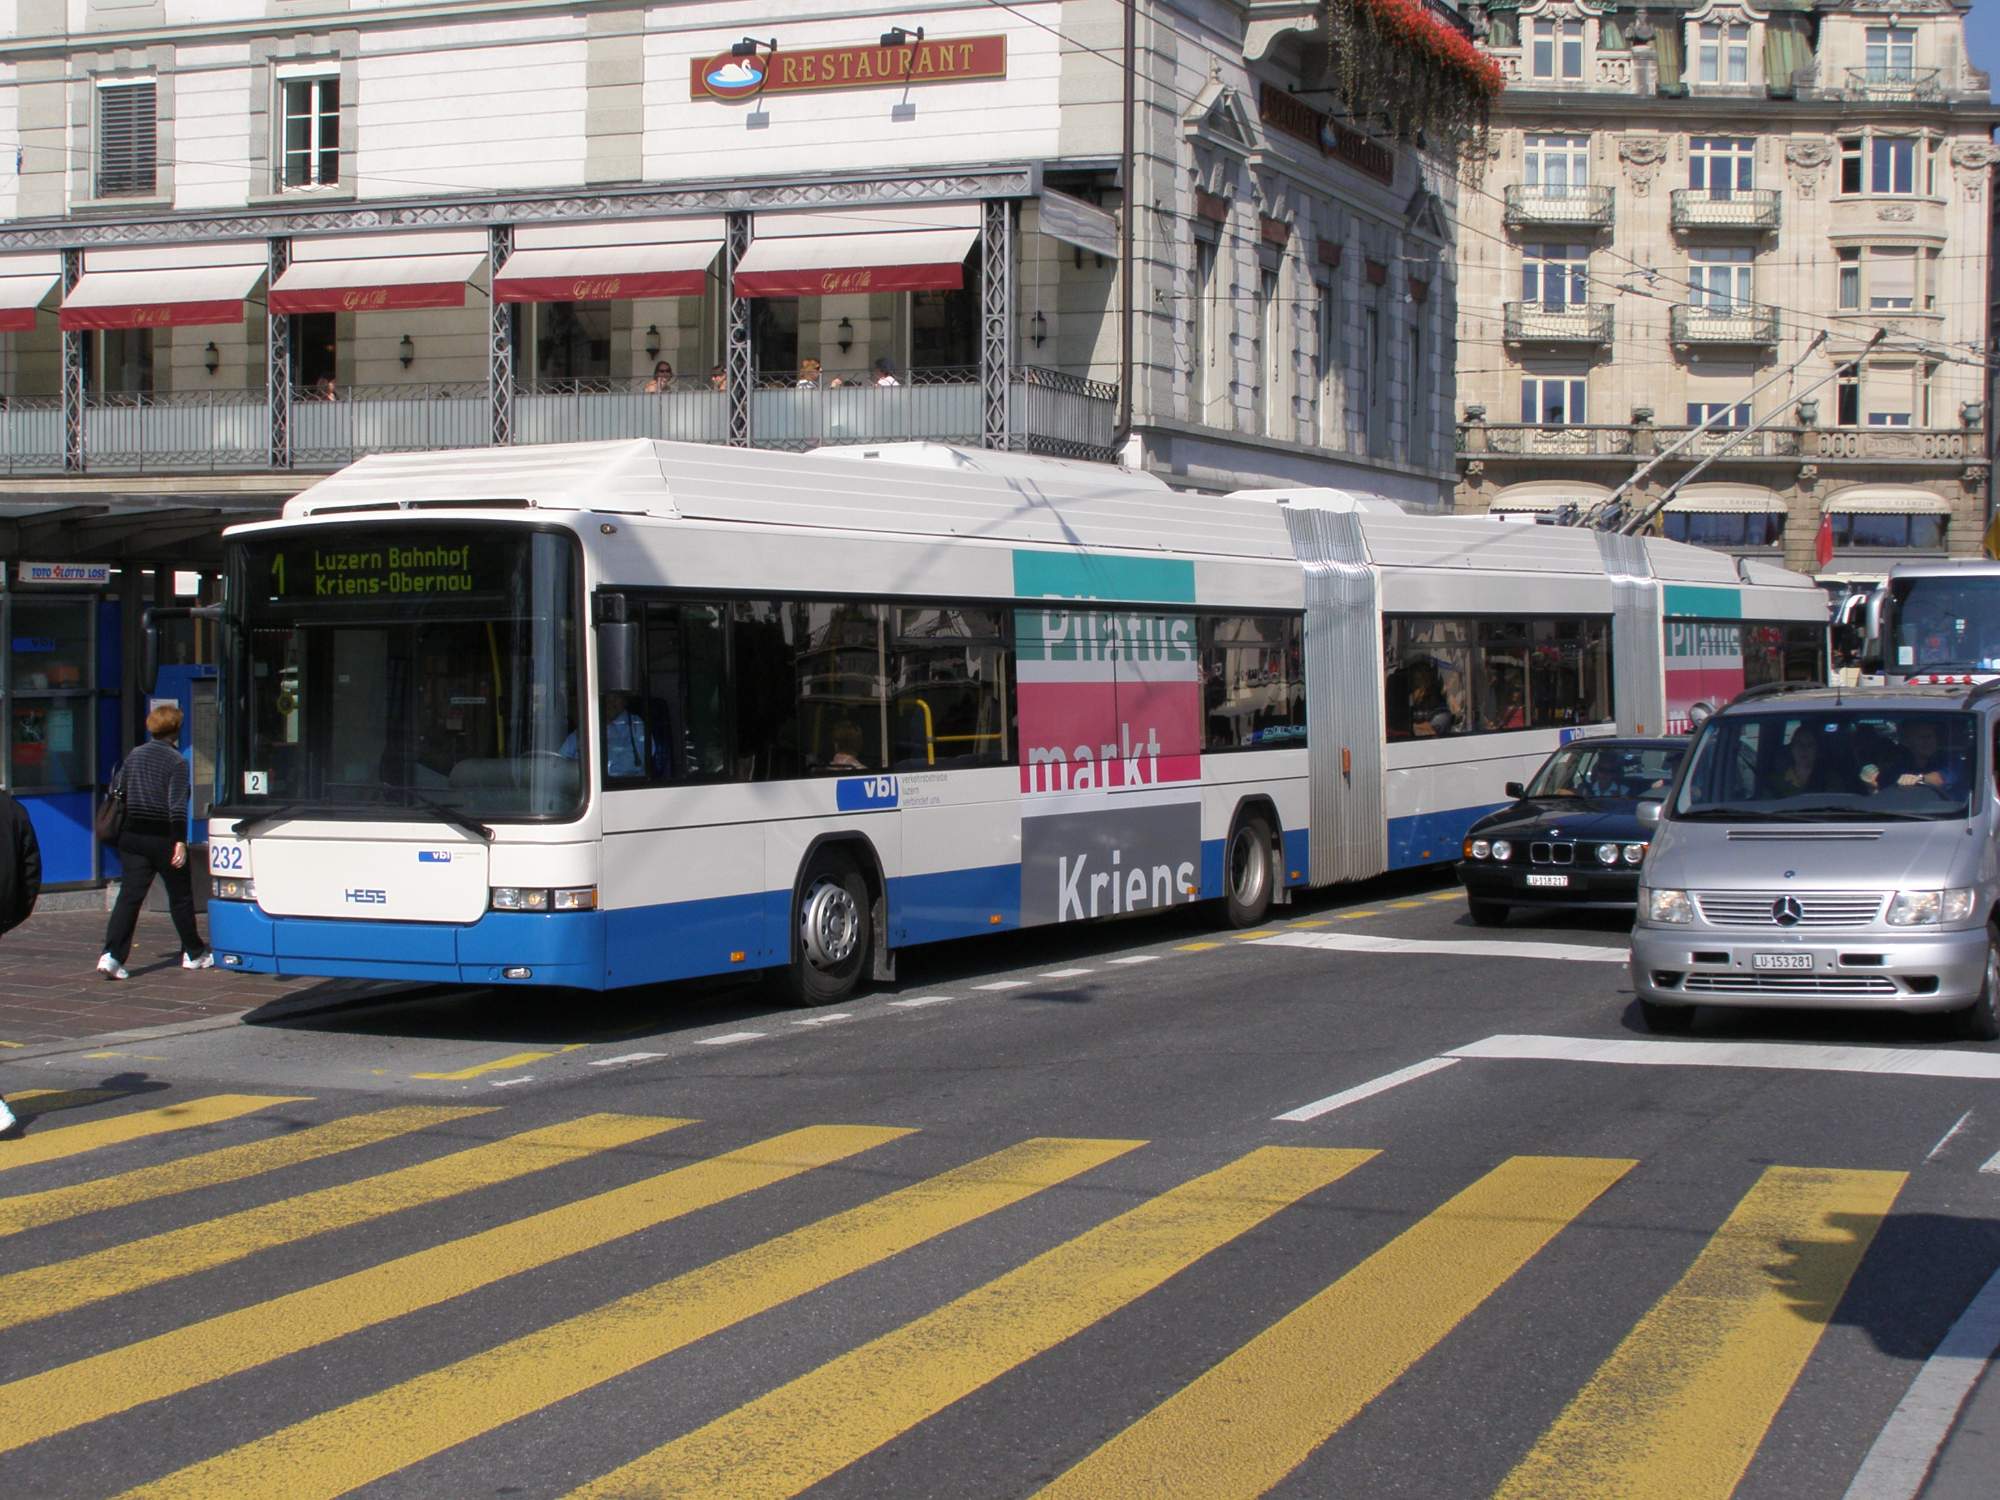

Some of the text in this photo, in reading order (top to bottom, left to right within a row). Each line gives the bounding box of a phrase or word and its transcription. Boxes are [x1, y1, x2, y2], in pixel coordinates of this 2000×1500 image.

[782, 43, 975, 83] RESTAURANT
[315, 545, 470, 571] Luzern Bahnhof
[32, 567, 107, 578] TOTO LOTTO LOSE
[272, 553, 285, 594] 1
[316, 571, 472, 595] Kriens-Obernau
[1042, 594, 1192, 661] Pilatus
[1671, 613, 1741, 656] Pilatus
[1028, 722, 1161, 793] markt
[251, 775, 260, 791] 2
[863, 775, 896, 798] vbl
[211, 846, 242, 869] 232
[431, 850, 451, 860] vbl
[345, 888, 387, 904] HESS
[1058, 850, 1196, 922] Kriens
